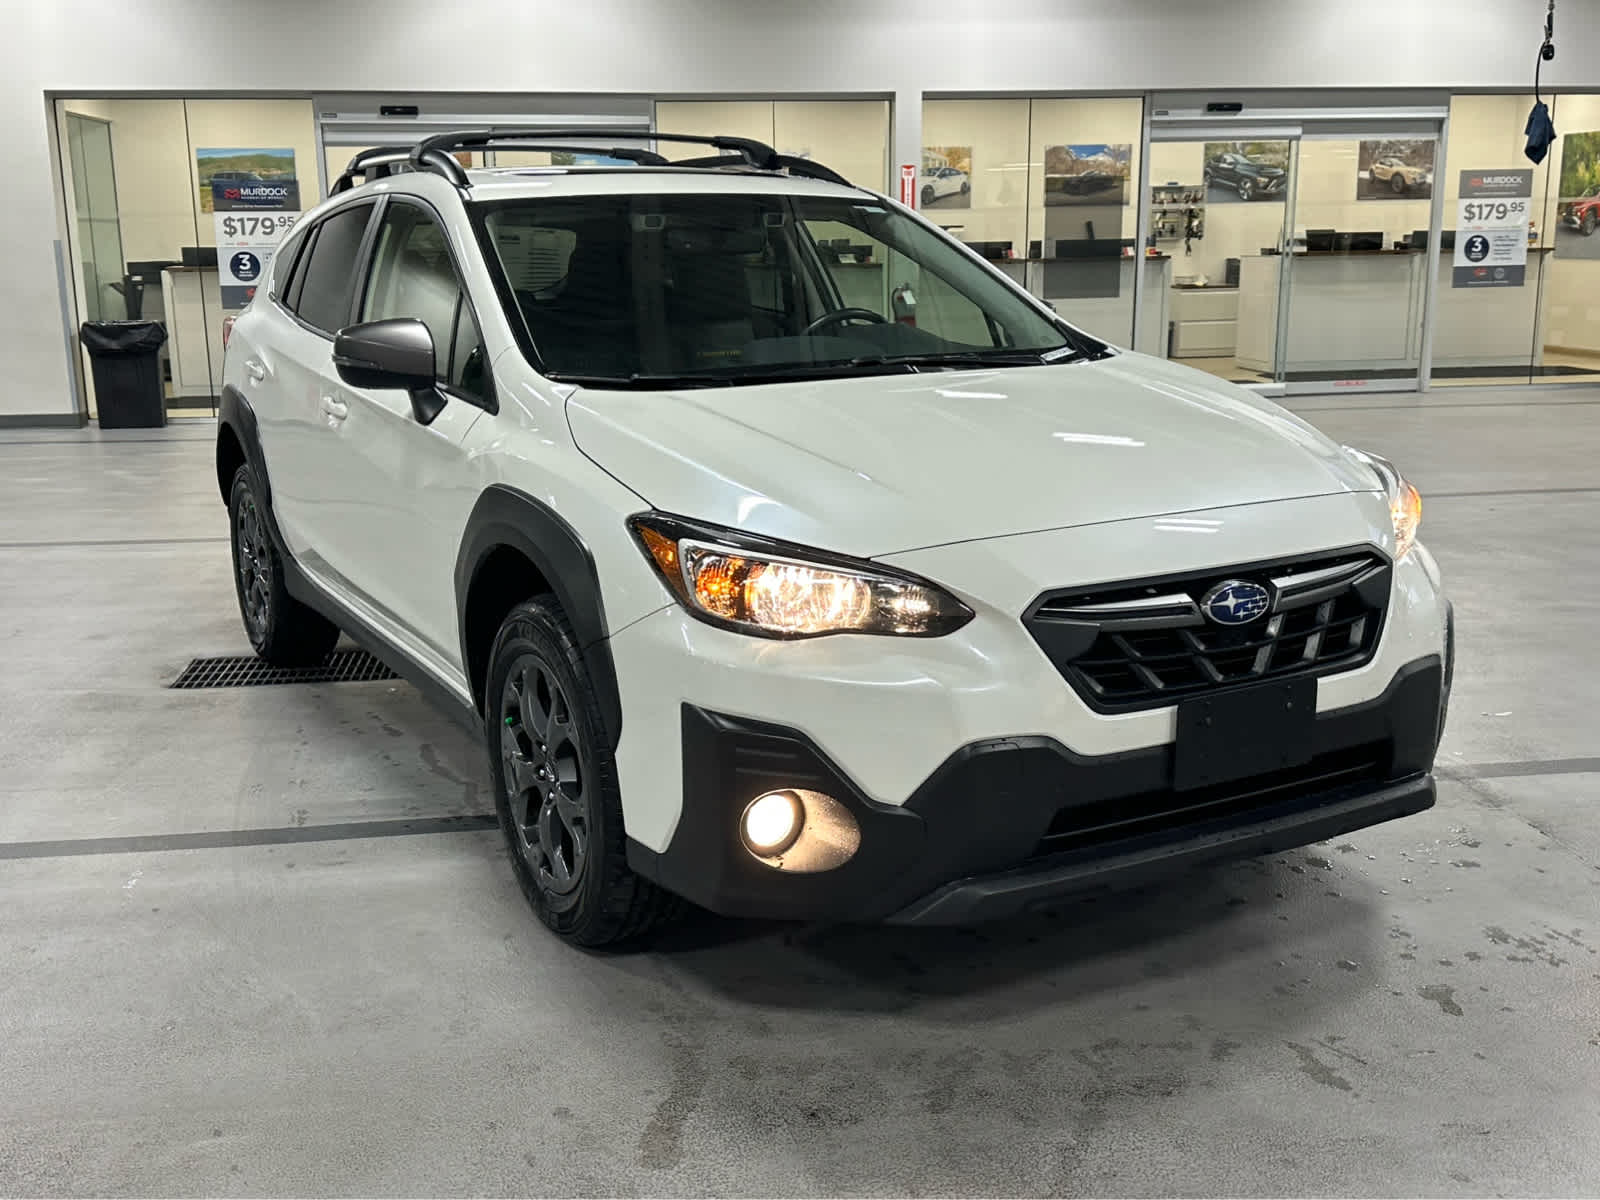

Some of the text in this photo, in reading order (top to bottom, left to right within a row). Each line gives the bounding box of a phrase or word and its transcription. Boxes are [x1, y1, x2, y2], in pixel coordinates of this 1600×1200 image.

[240, 187, 287, 196] MURDOCK
[1464, 202, 1525, 223] $179.95
[223, 216, 294, 237] $179.95
[1471, 237, 1482, 252] 3
[238, 254, 251, 270] 3
